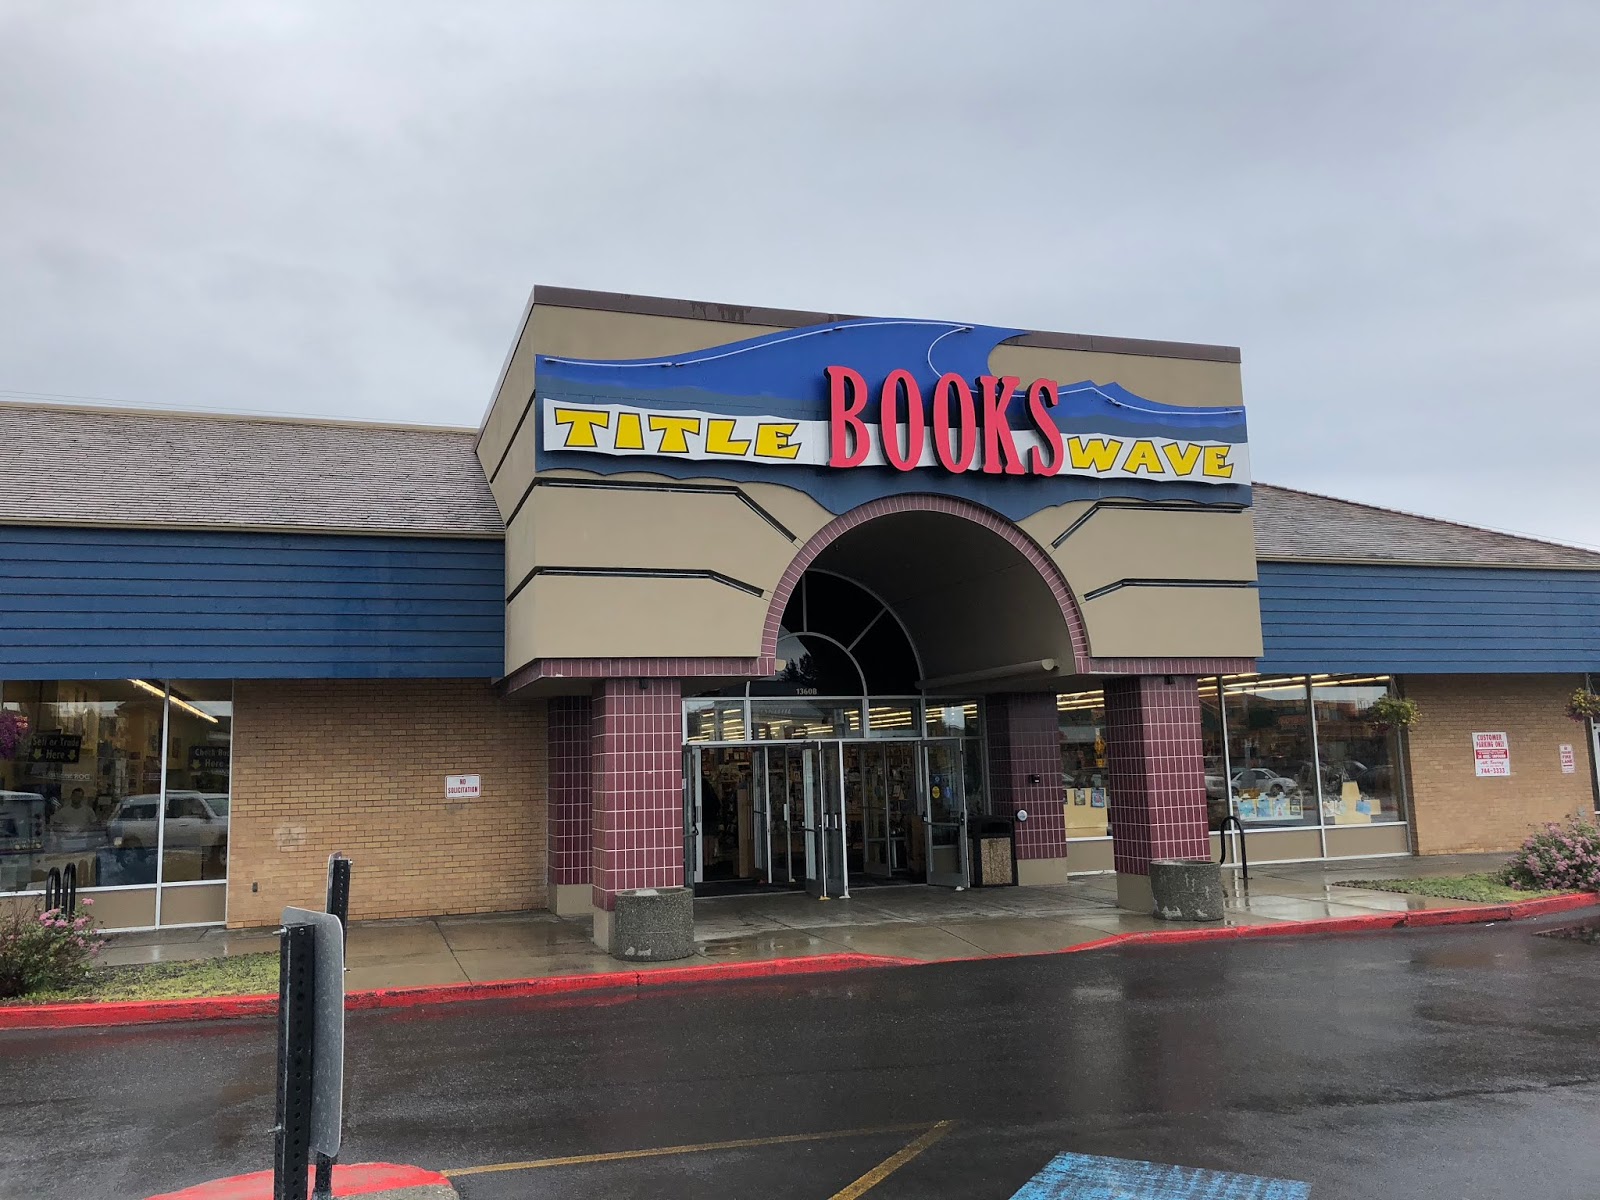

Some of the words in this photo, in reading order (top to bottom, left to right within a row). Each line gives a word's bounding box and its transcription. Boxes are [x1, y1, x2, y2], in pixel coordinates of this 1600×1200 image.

[554, 407, 802, 459] TITLE
[824, 366, 1064, 477] BOOKS
[1067, 436, 1234, 478] WAVE
[32, 736, 47, 746] Sell
[60, 737, 80, 747] Trade
[46, 750, 65, 759] Here
[205, 759, 224, 768] Here
[448, 786, 478, 794] SOLICITATION
